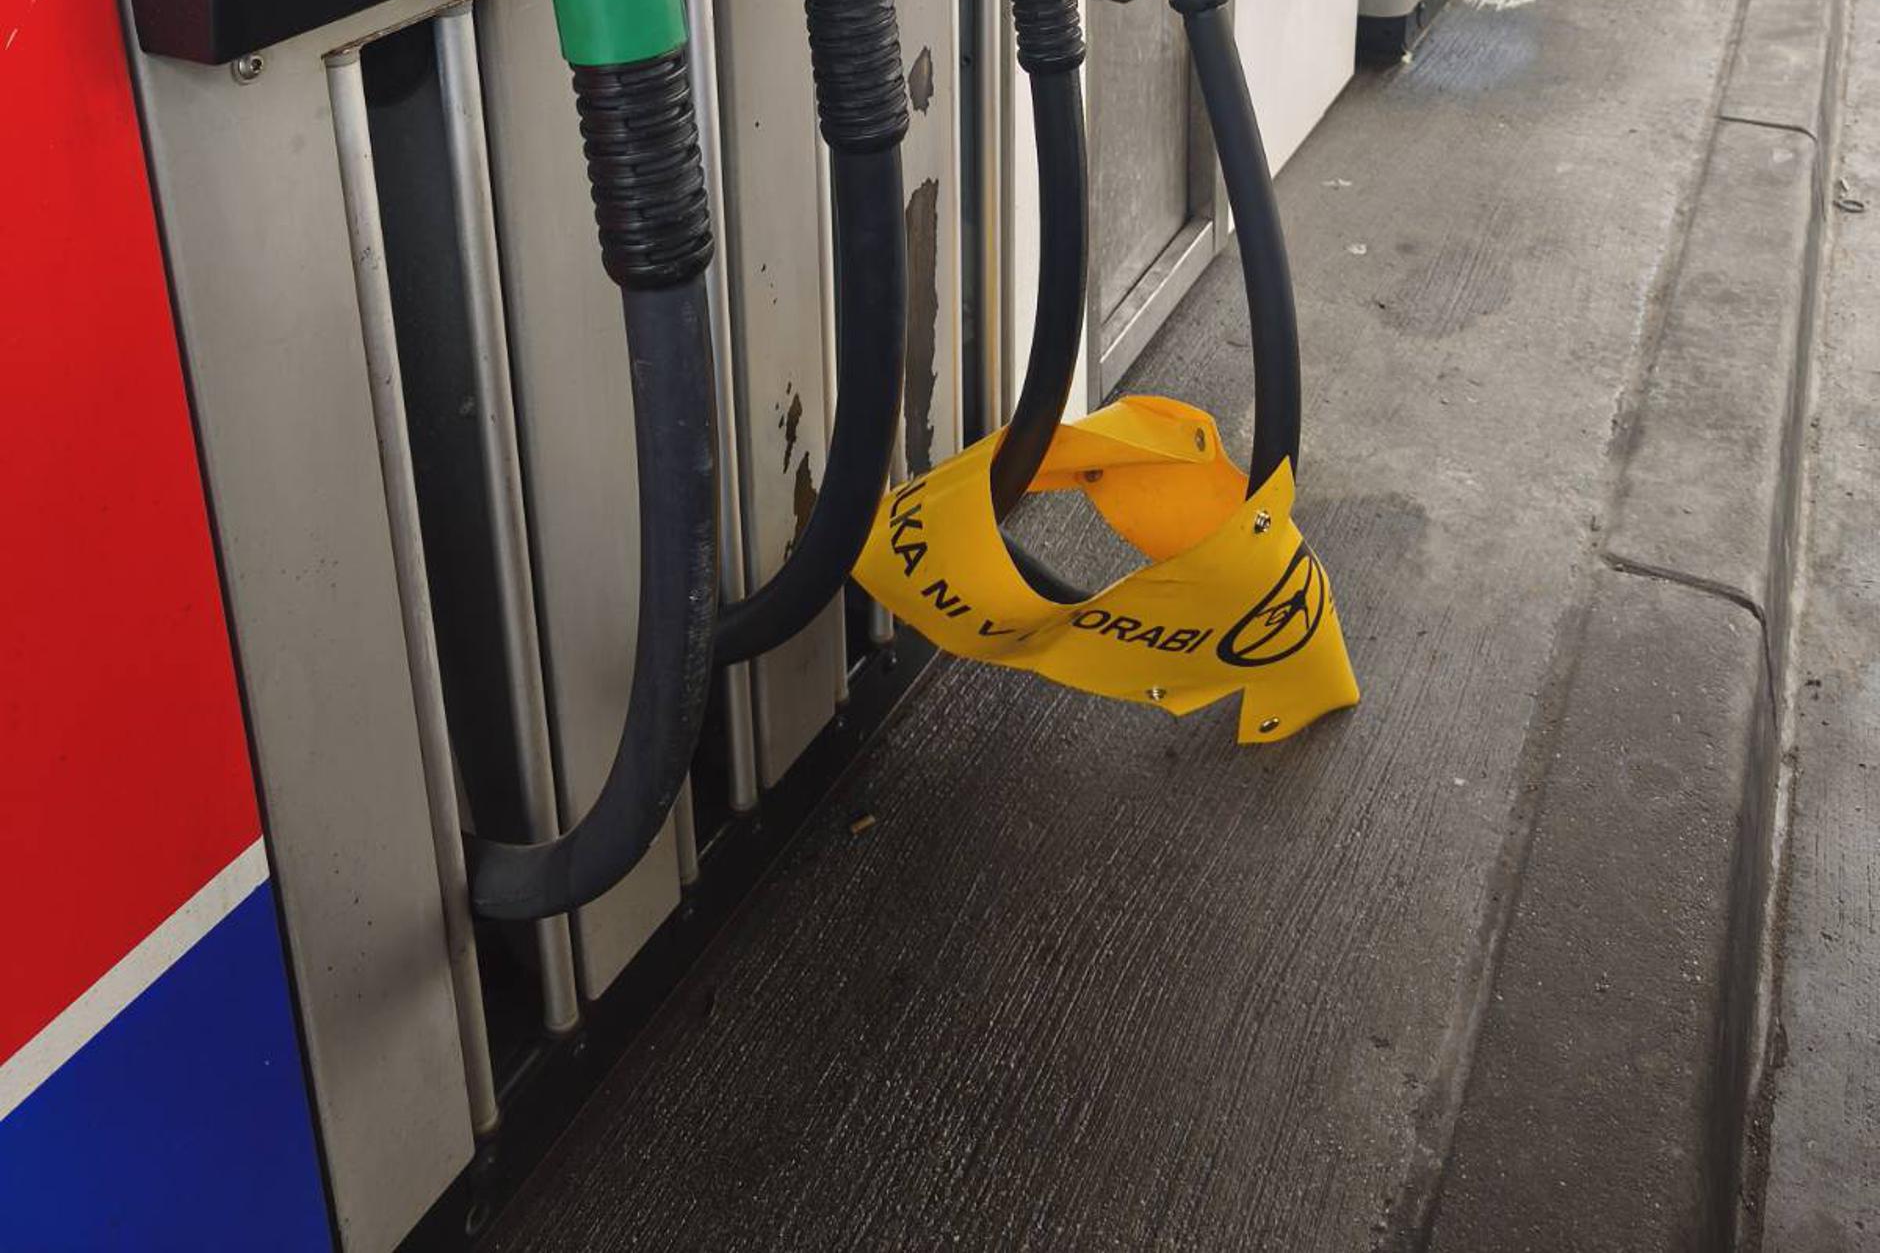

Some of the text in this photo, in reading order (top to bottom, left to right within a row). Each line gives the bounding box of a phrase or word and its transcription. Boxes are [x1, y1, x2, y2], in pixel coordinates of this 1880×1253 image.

[890, 481, 928, 577] LKA
[921, 579, 972, 618] NI
[1070, 609, 1215, 654] ORABI
